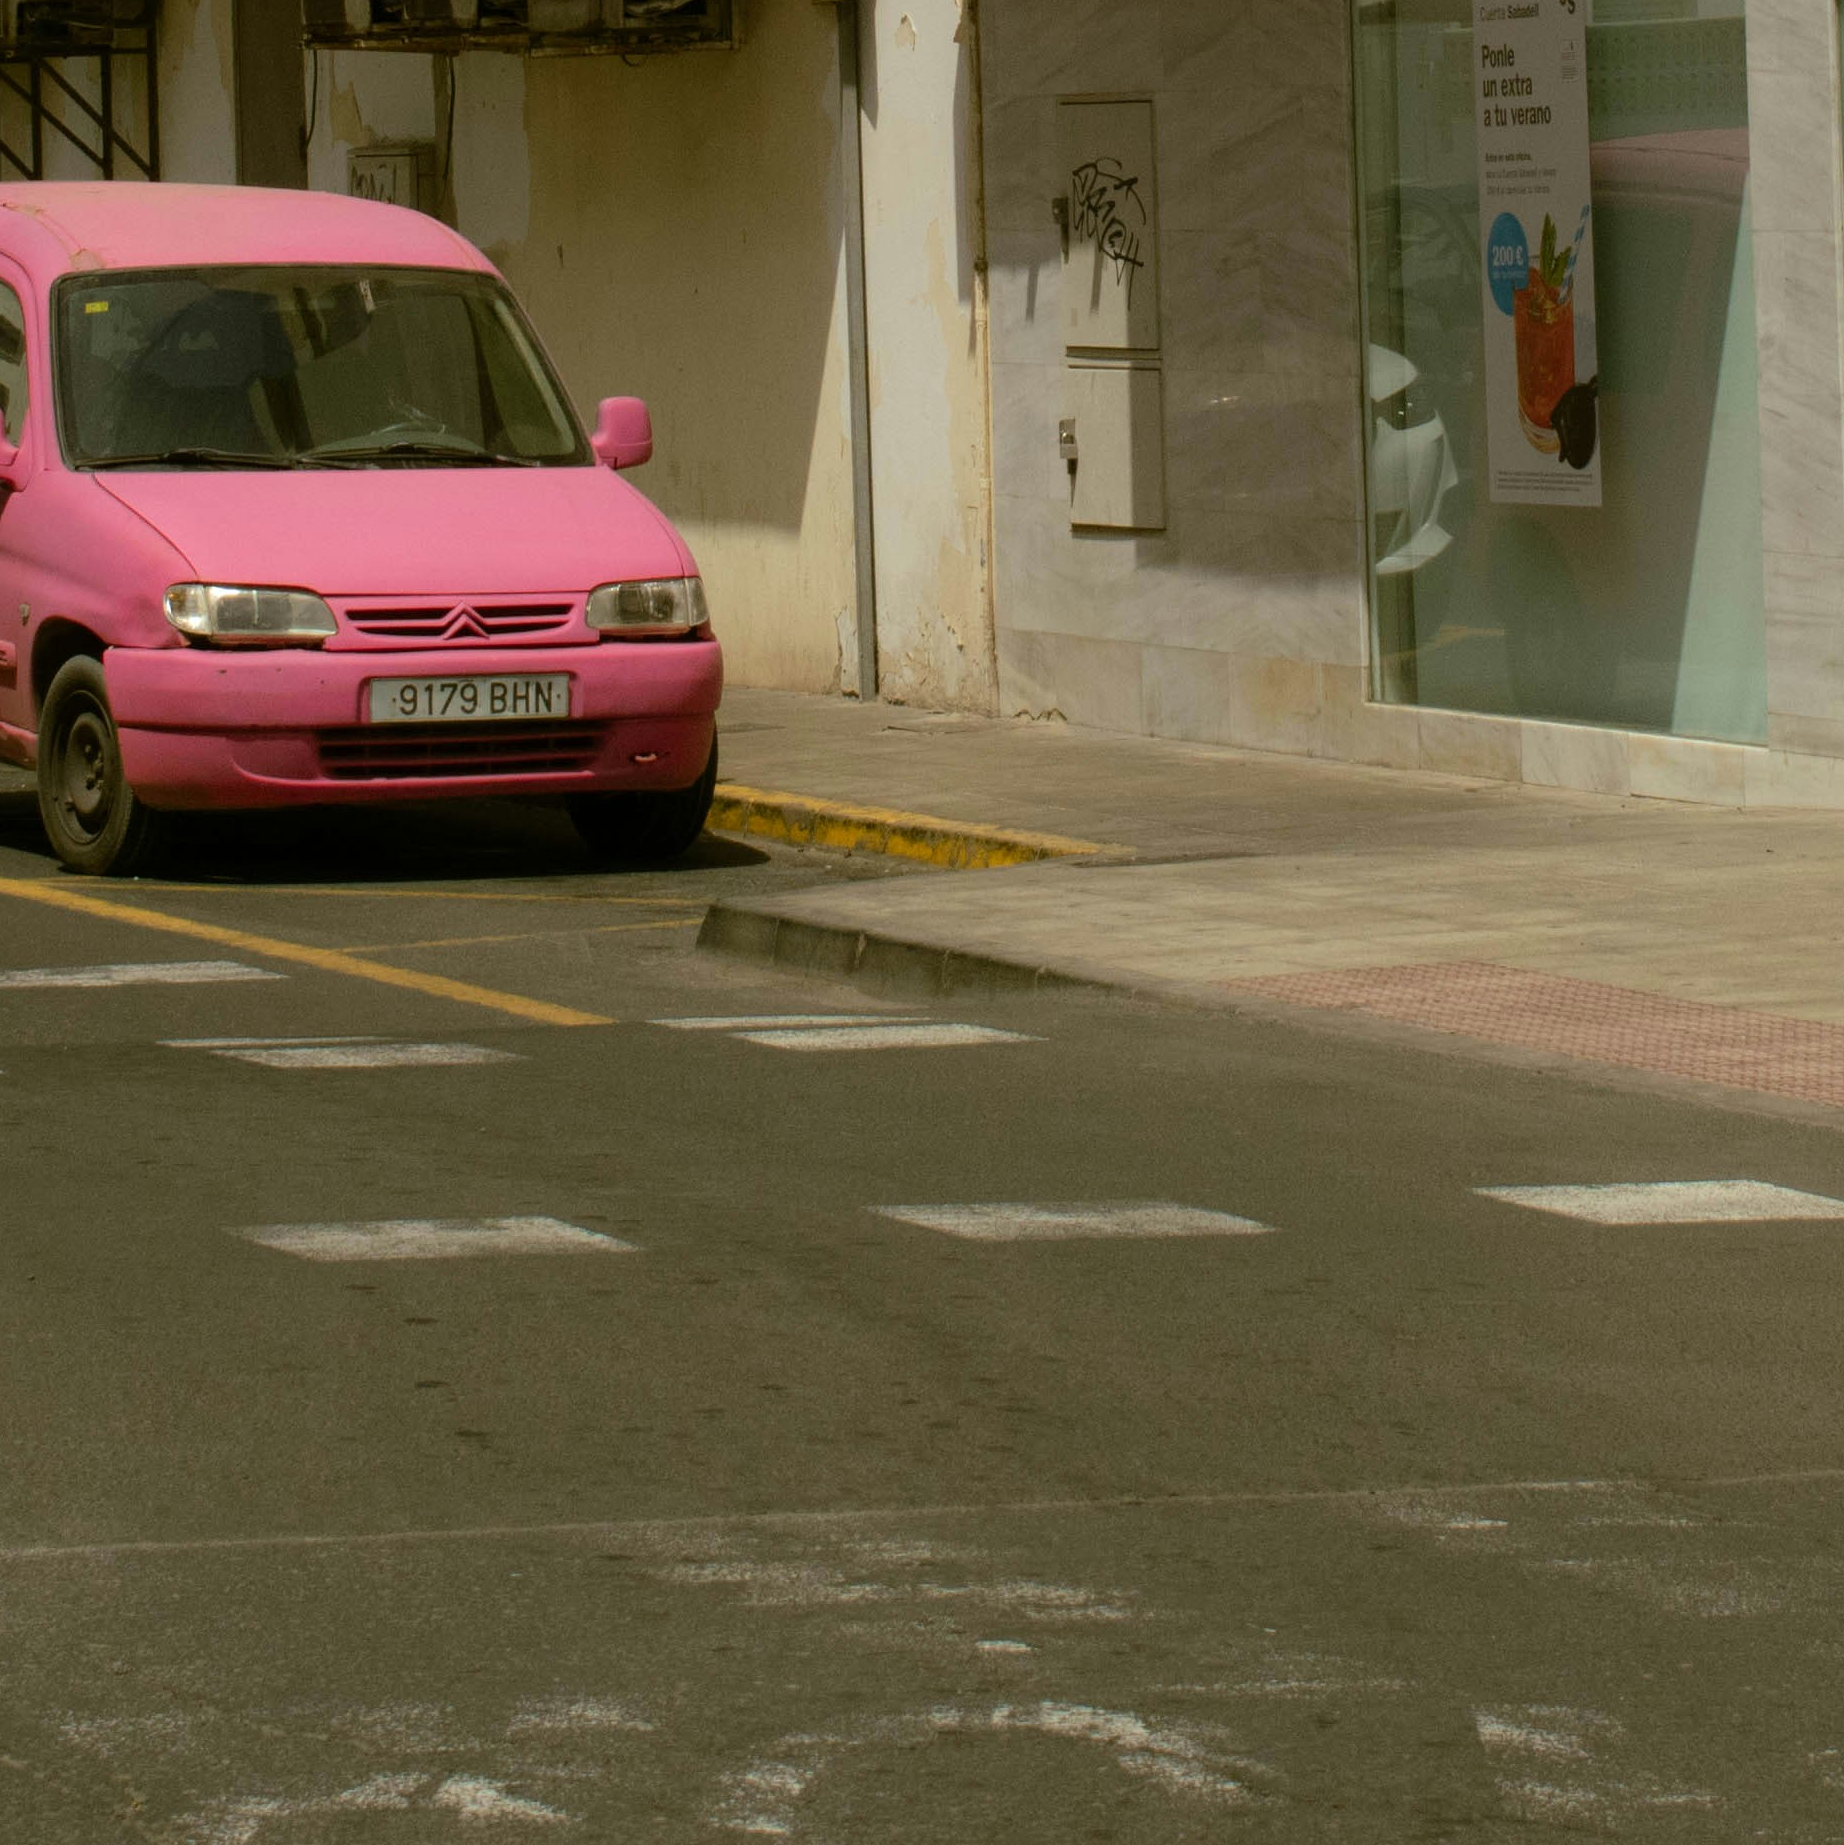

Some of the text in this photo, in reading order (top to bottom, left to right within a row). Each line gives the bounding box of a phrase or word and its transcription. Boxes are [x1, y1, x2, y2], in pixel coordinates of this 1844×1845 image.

[1508, 3, 1540, 19] Sabadell
[1482, 43, 1515, 68] Ponle
[1482, 73, 1533, 98] un extra
[1483, 104, 1553, 127] a tu verano
[1492, 245, 1524, 268] 200 €
[399, 681, 553, 716] 9179 BHN
